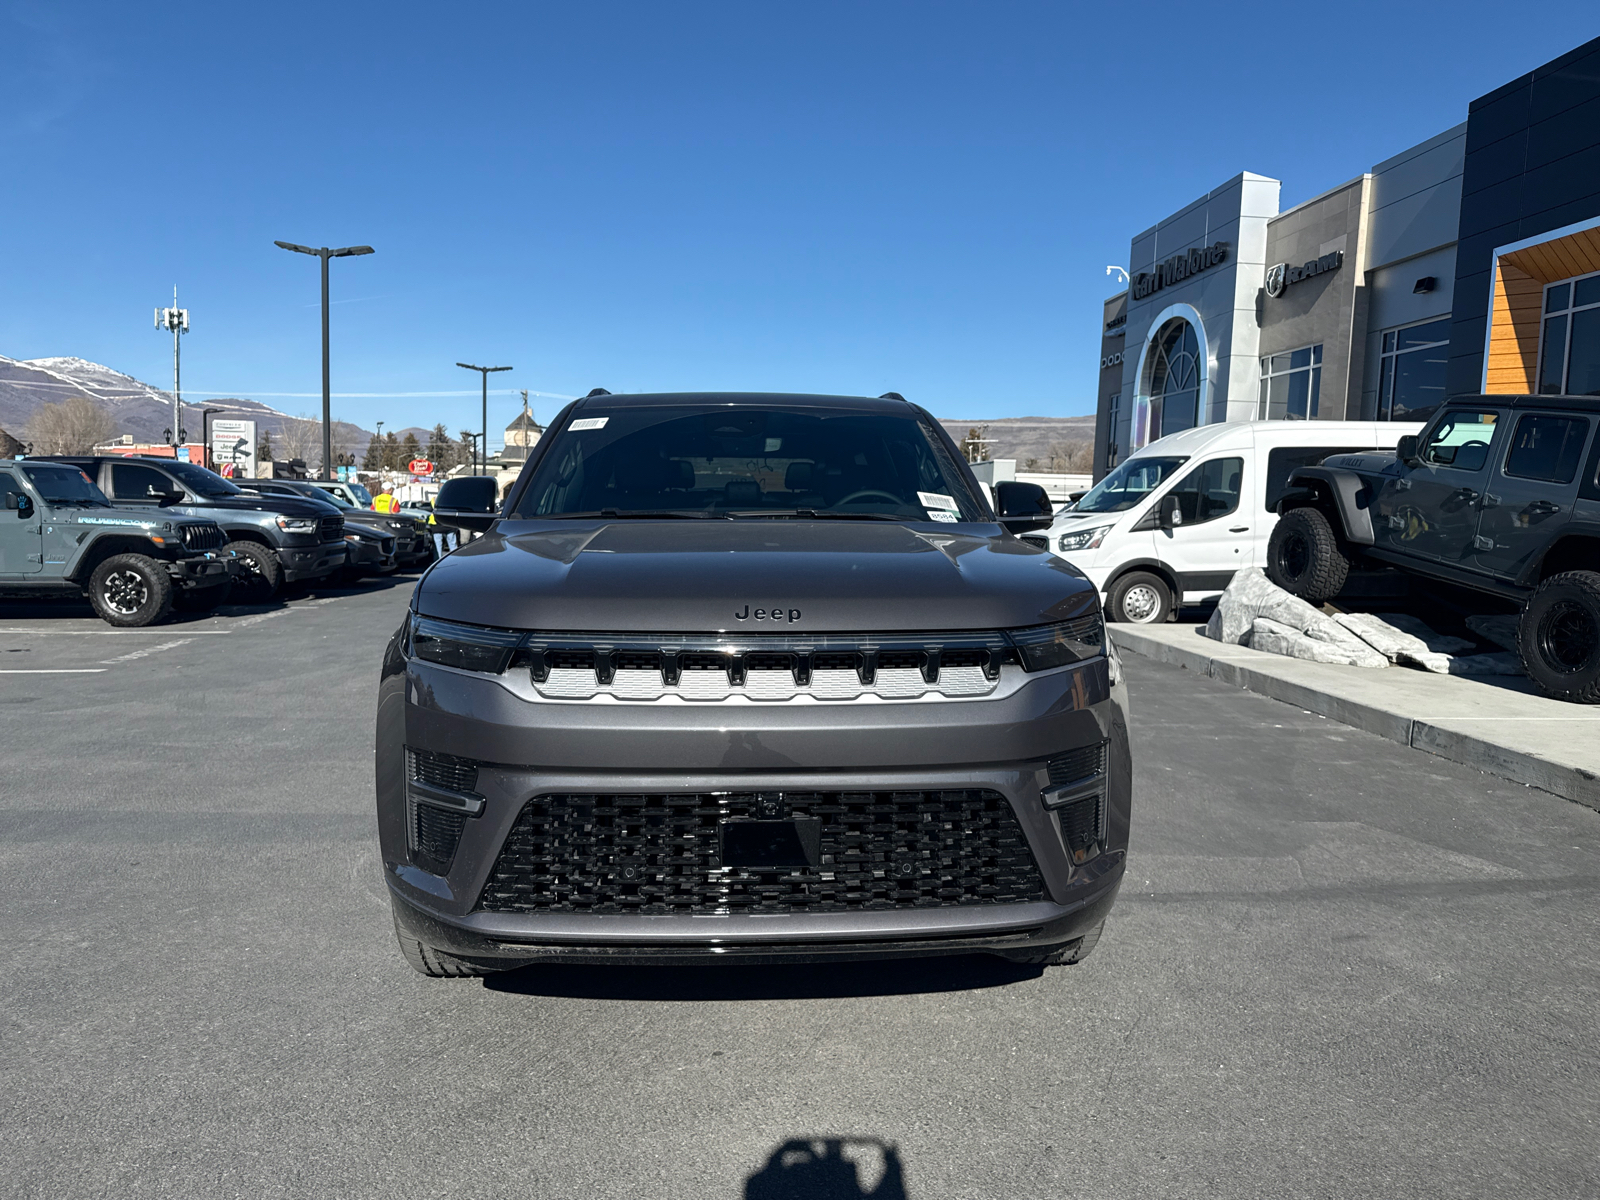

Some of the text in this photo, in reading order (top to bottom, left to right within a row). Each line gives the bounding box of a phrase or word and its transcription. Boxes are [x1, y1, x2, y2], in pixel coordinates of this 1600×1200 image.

[1132, 241, 1226, 300] Karl Malone
[1285, 251, 1343, 285] RAM
[734, 605, 802, 624] Jeep
